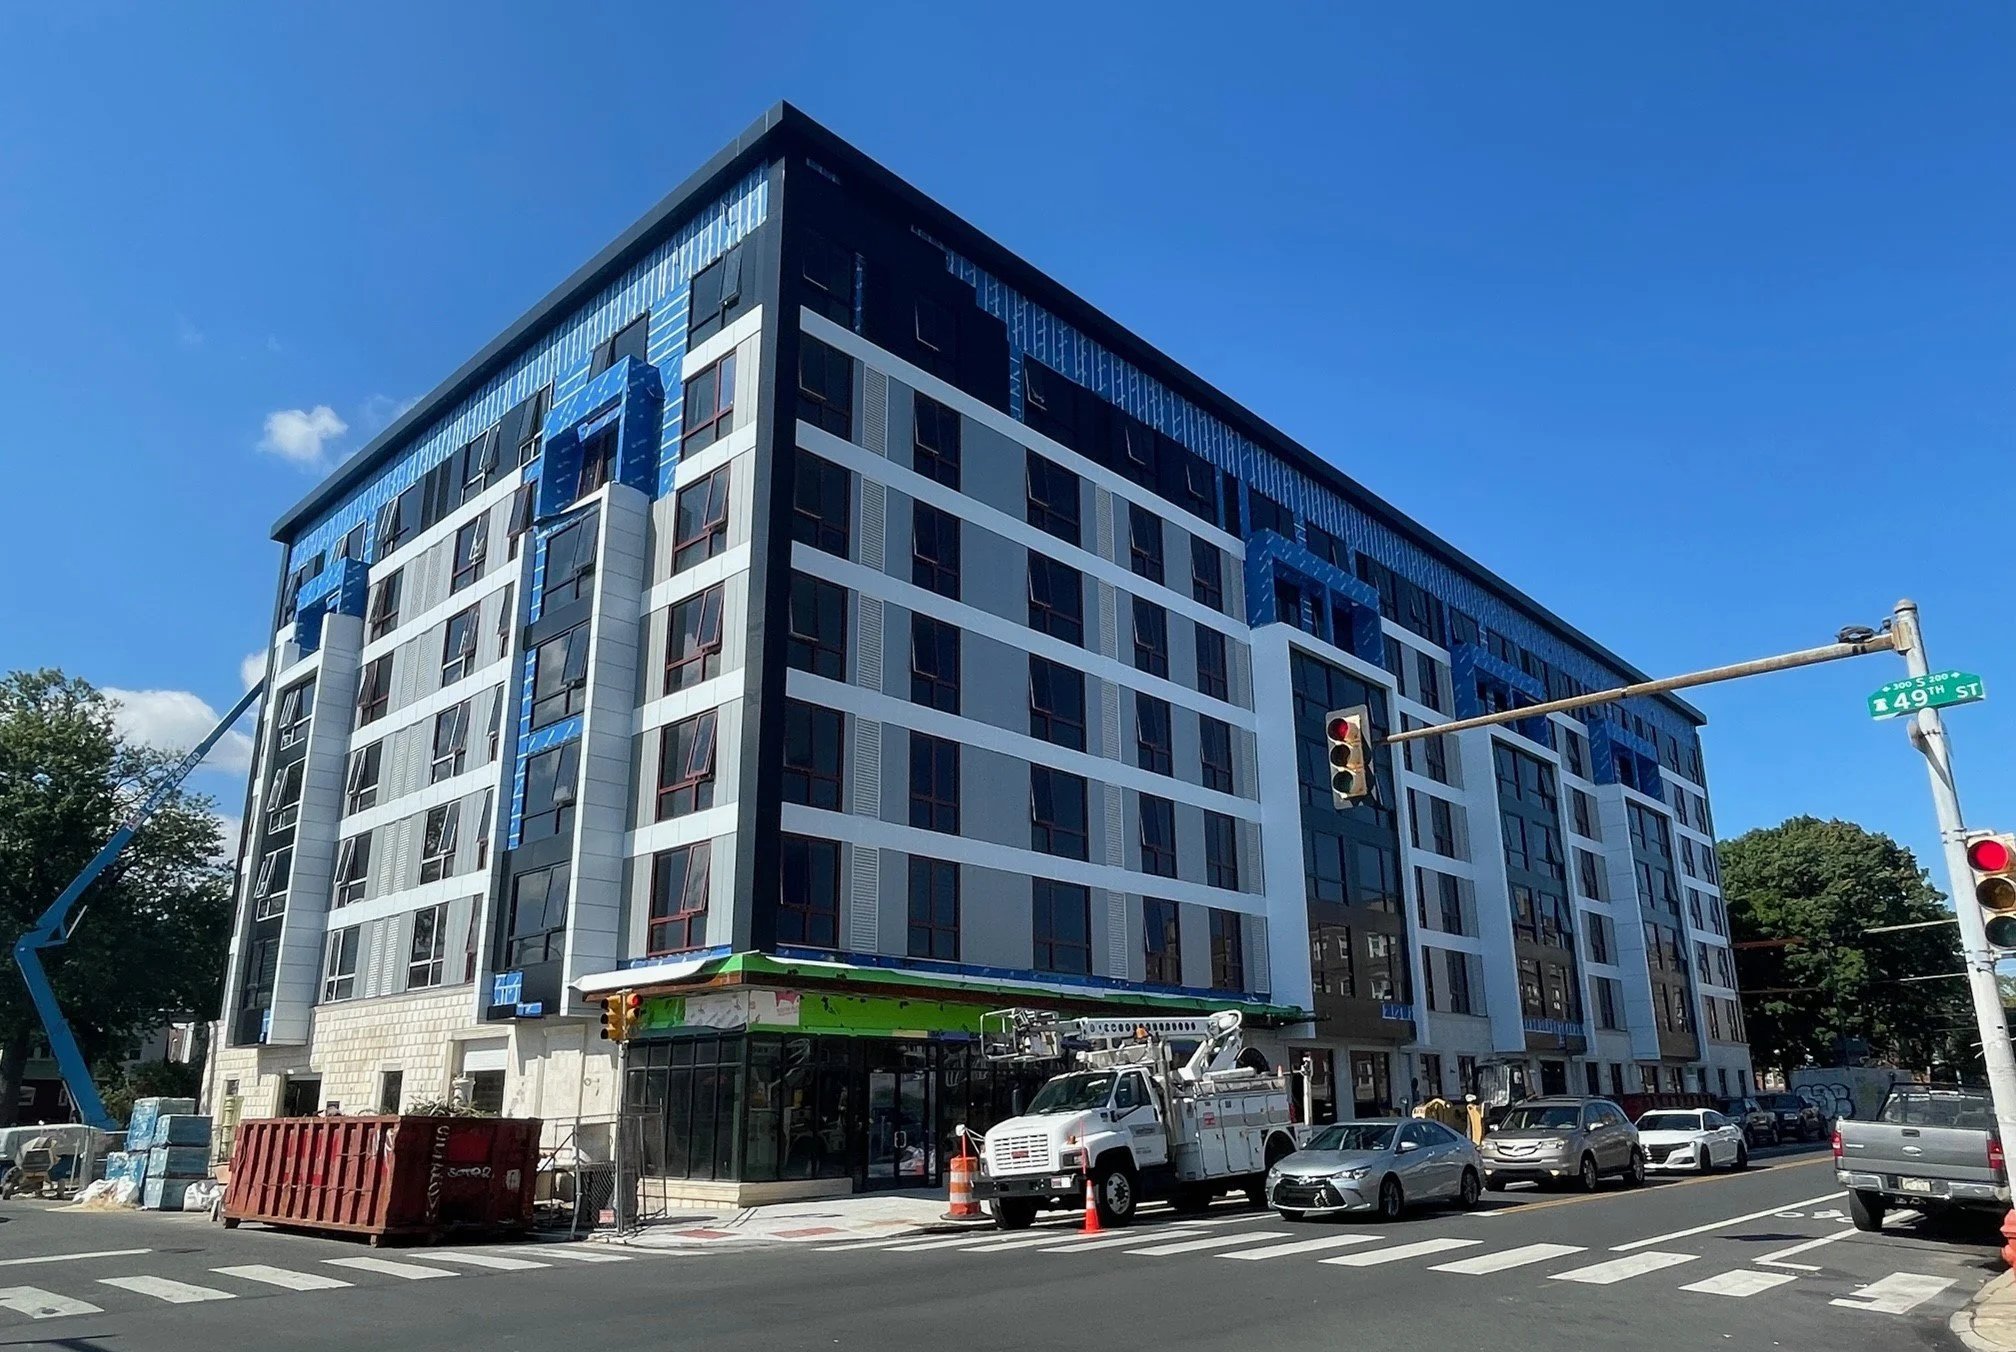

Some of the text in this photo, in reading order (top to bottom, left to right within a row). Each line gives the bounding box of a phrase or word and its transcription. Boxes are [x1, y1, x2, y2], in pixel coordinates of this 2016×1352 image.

[1893, 673, 1948, 690] 300 S 200
[1955, 682, 1979, 699] ST
